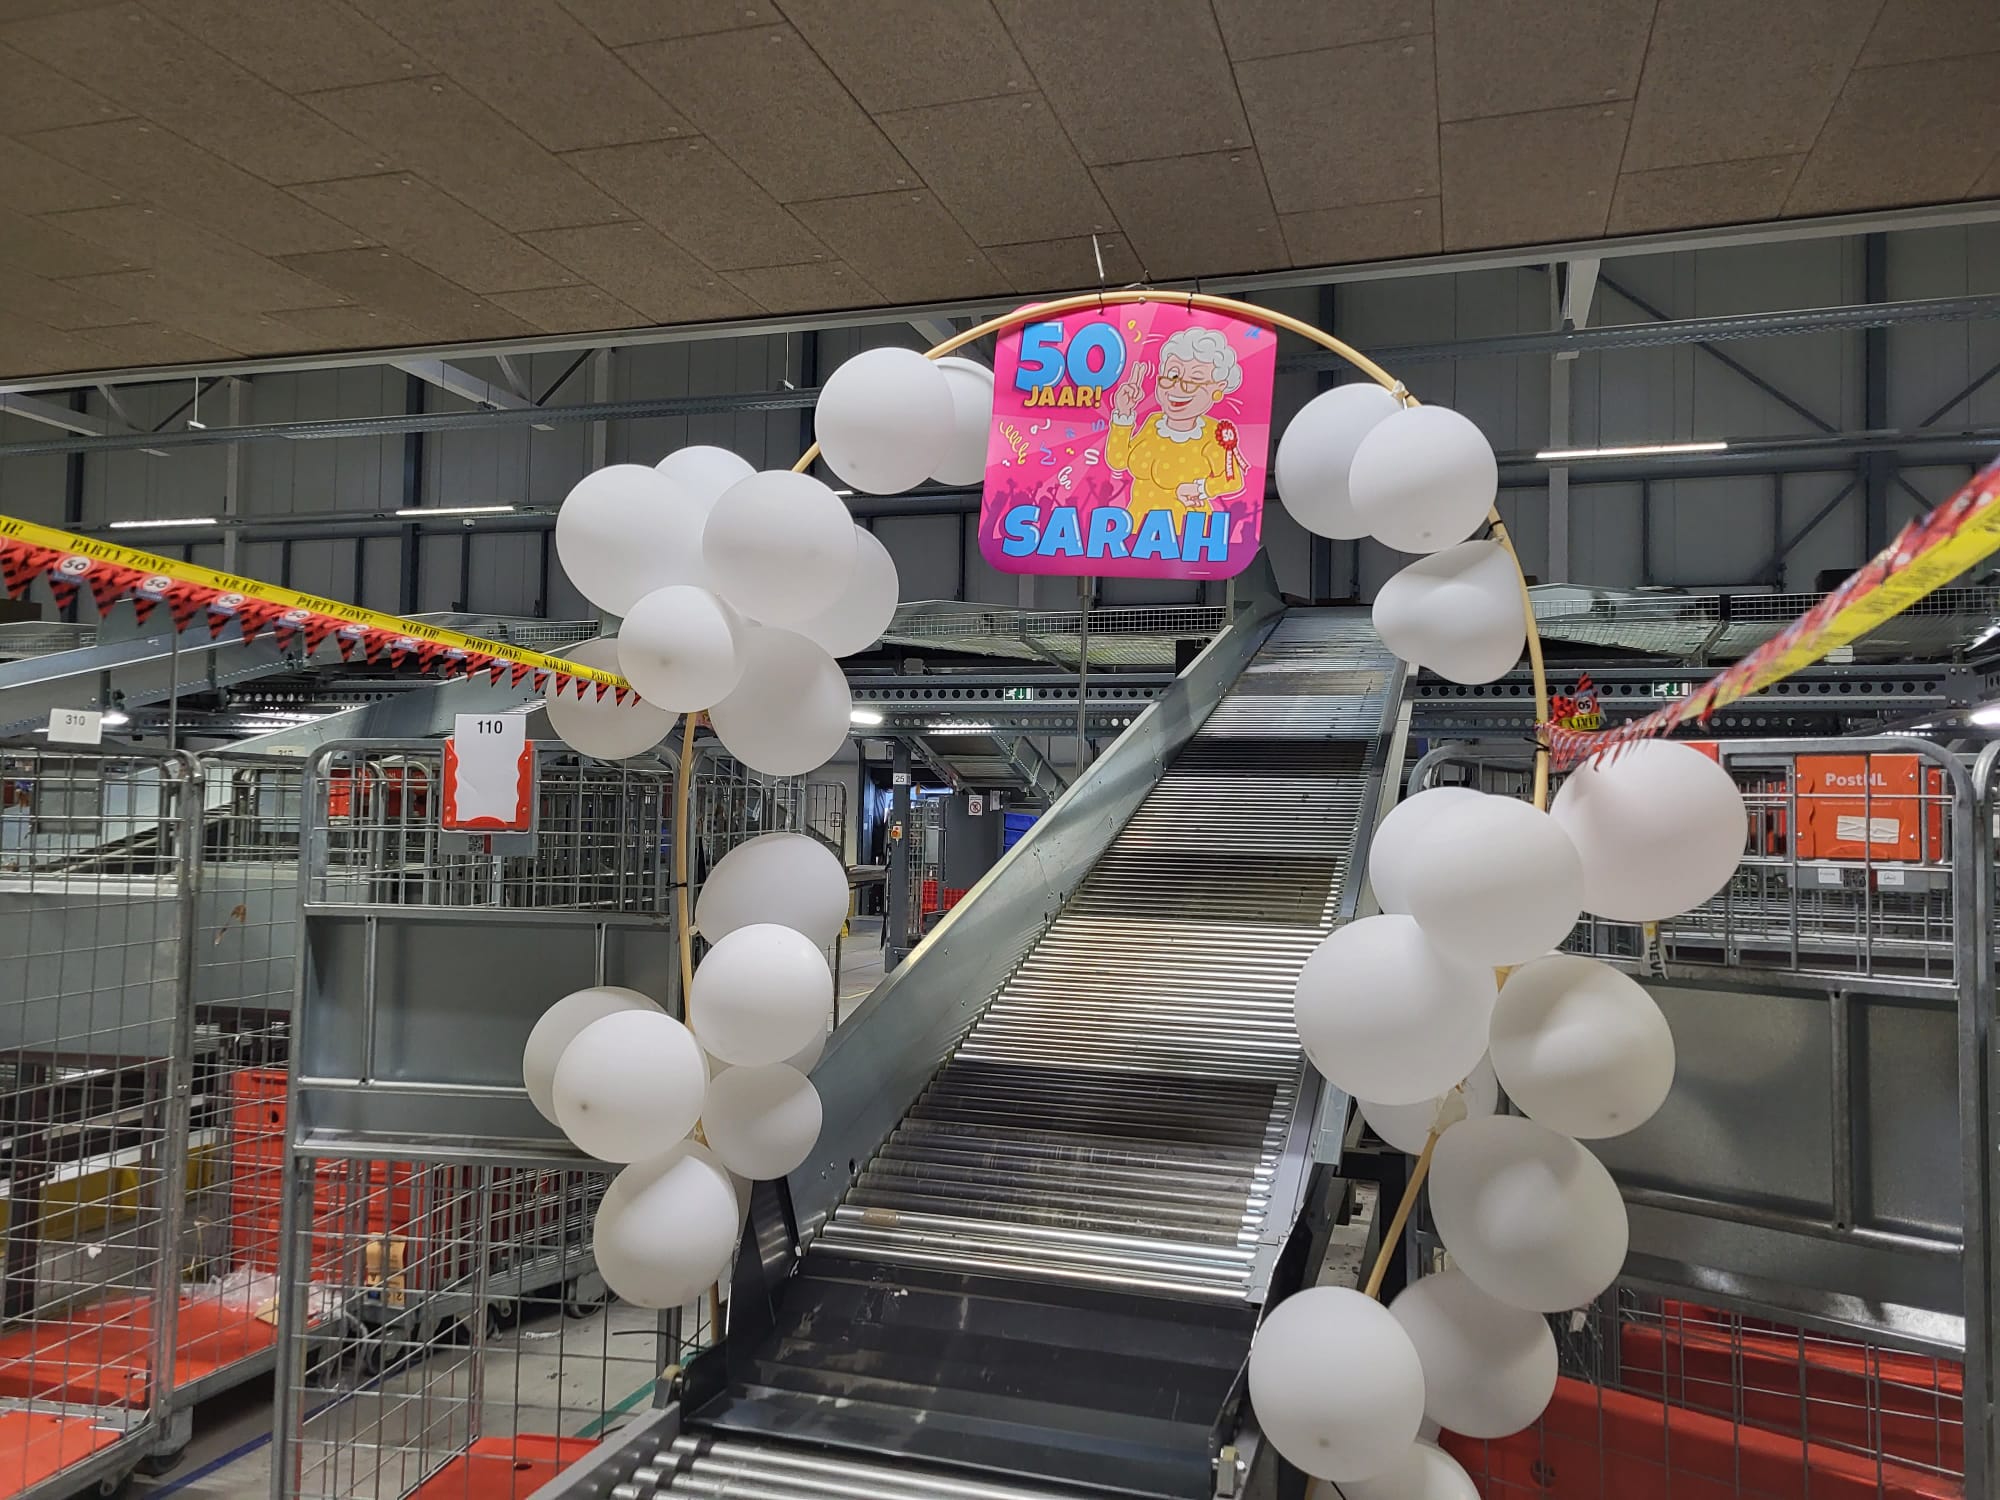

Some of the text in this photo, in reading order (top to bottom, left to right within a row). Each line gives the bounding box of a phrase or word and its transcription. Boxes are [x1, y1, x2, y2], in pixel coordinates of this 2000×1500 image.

[1015, 321, 1127, 392] 50
[1024, 386, 1103, 408] JAAR!
[1222, 429, 1234, 441] 50
[1001, 504, 1231, 563] SARAH
[63, 560, 87, 571] 50
[146, 580, 168, 589] 50
[70, 538, 122, 561] PARTY
[127, 553, 175, 574] ZONE!
[296, 596, 334, 612] PARTY
[339, 607, 374, 623] ZONE!
[402, 623, 440, 640] SARAH!
[464, 638, 494, 655] PARTY
[495, 646, 522, 660] ZONE!
[542, 658, 572, 673] SARAH!
[591, 670, 613, 684] PARTY
[65, 714, 86, 726] 310
[477, 720, 503, 734] 110
[895, 775, 905, 783] 25
[1825, 772, 1888, 787] PostNL
